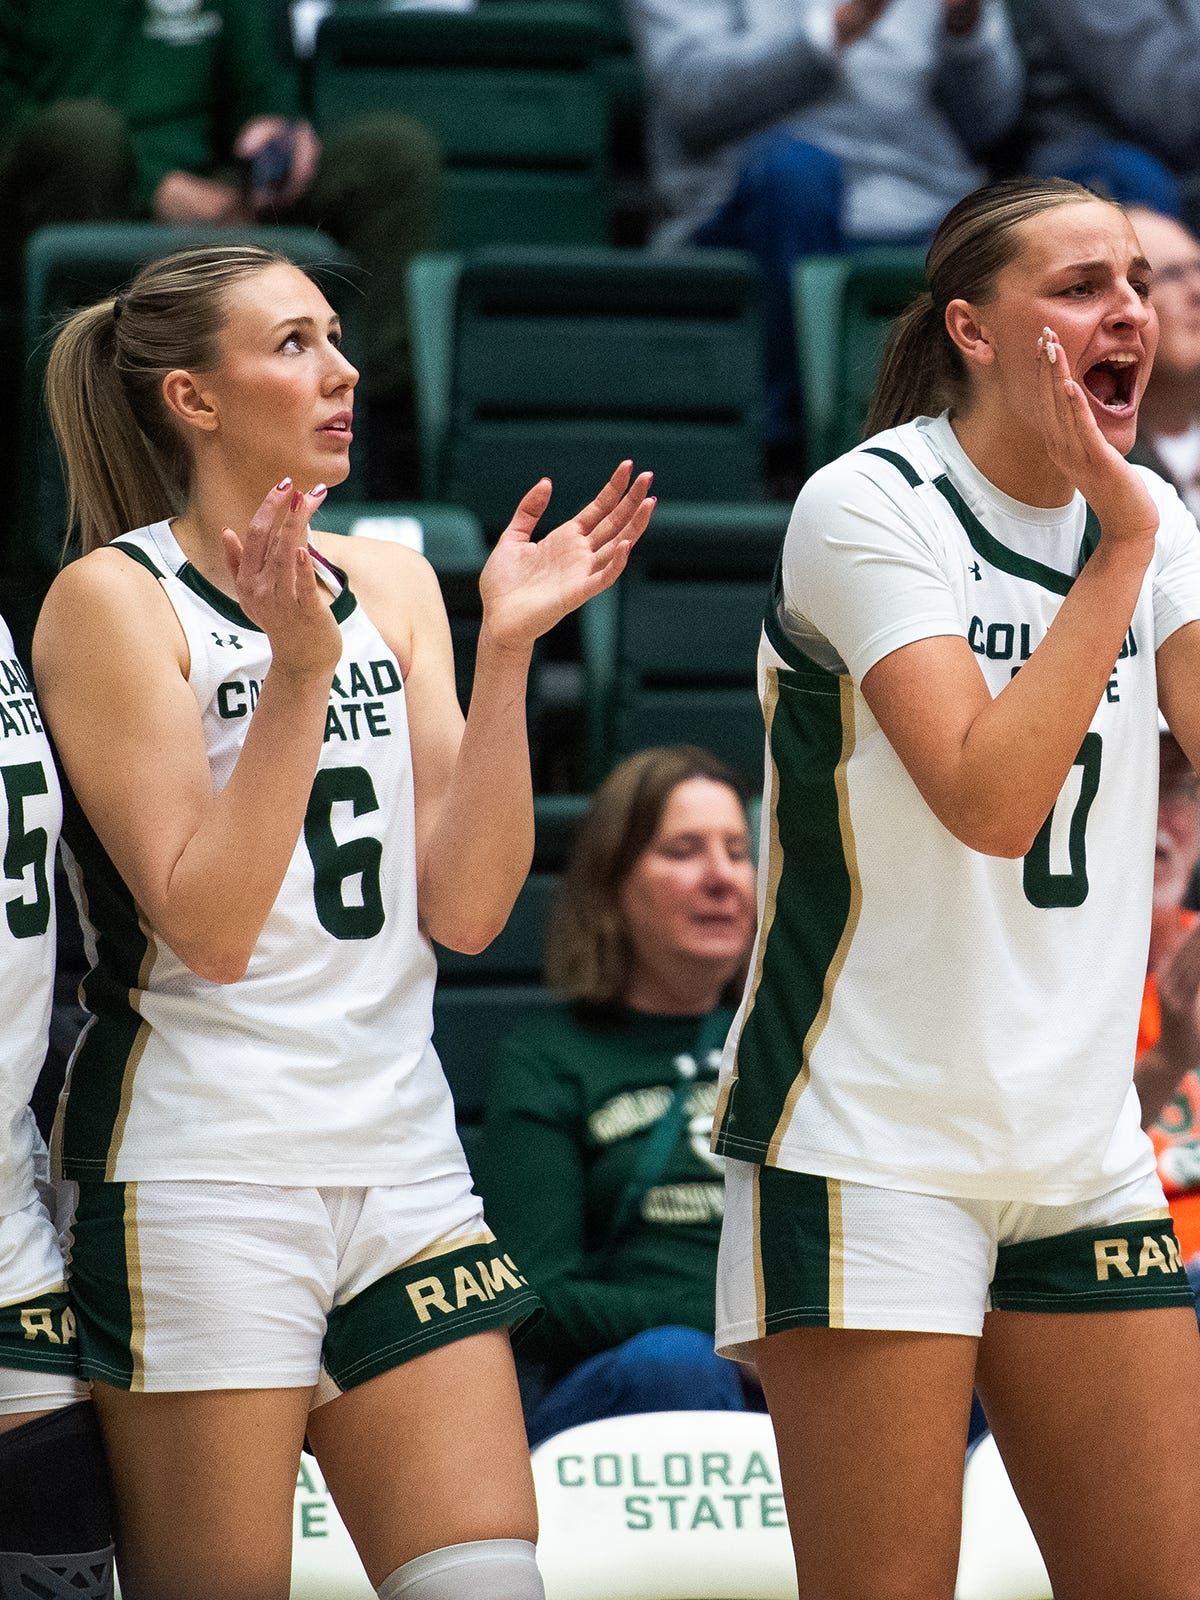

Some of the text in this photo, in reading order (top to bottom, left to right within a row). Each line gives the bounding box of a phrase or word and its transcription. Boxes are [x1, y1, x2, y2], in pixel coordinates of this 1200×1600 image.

[0, 761, 50, 938] 5
[304, 766, 386, 939] 6
[556, 1451, 774, 1488] COLORA
[624, 1493, 786, 1531] STATE
